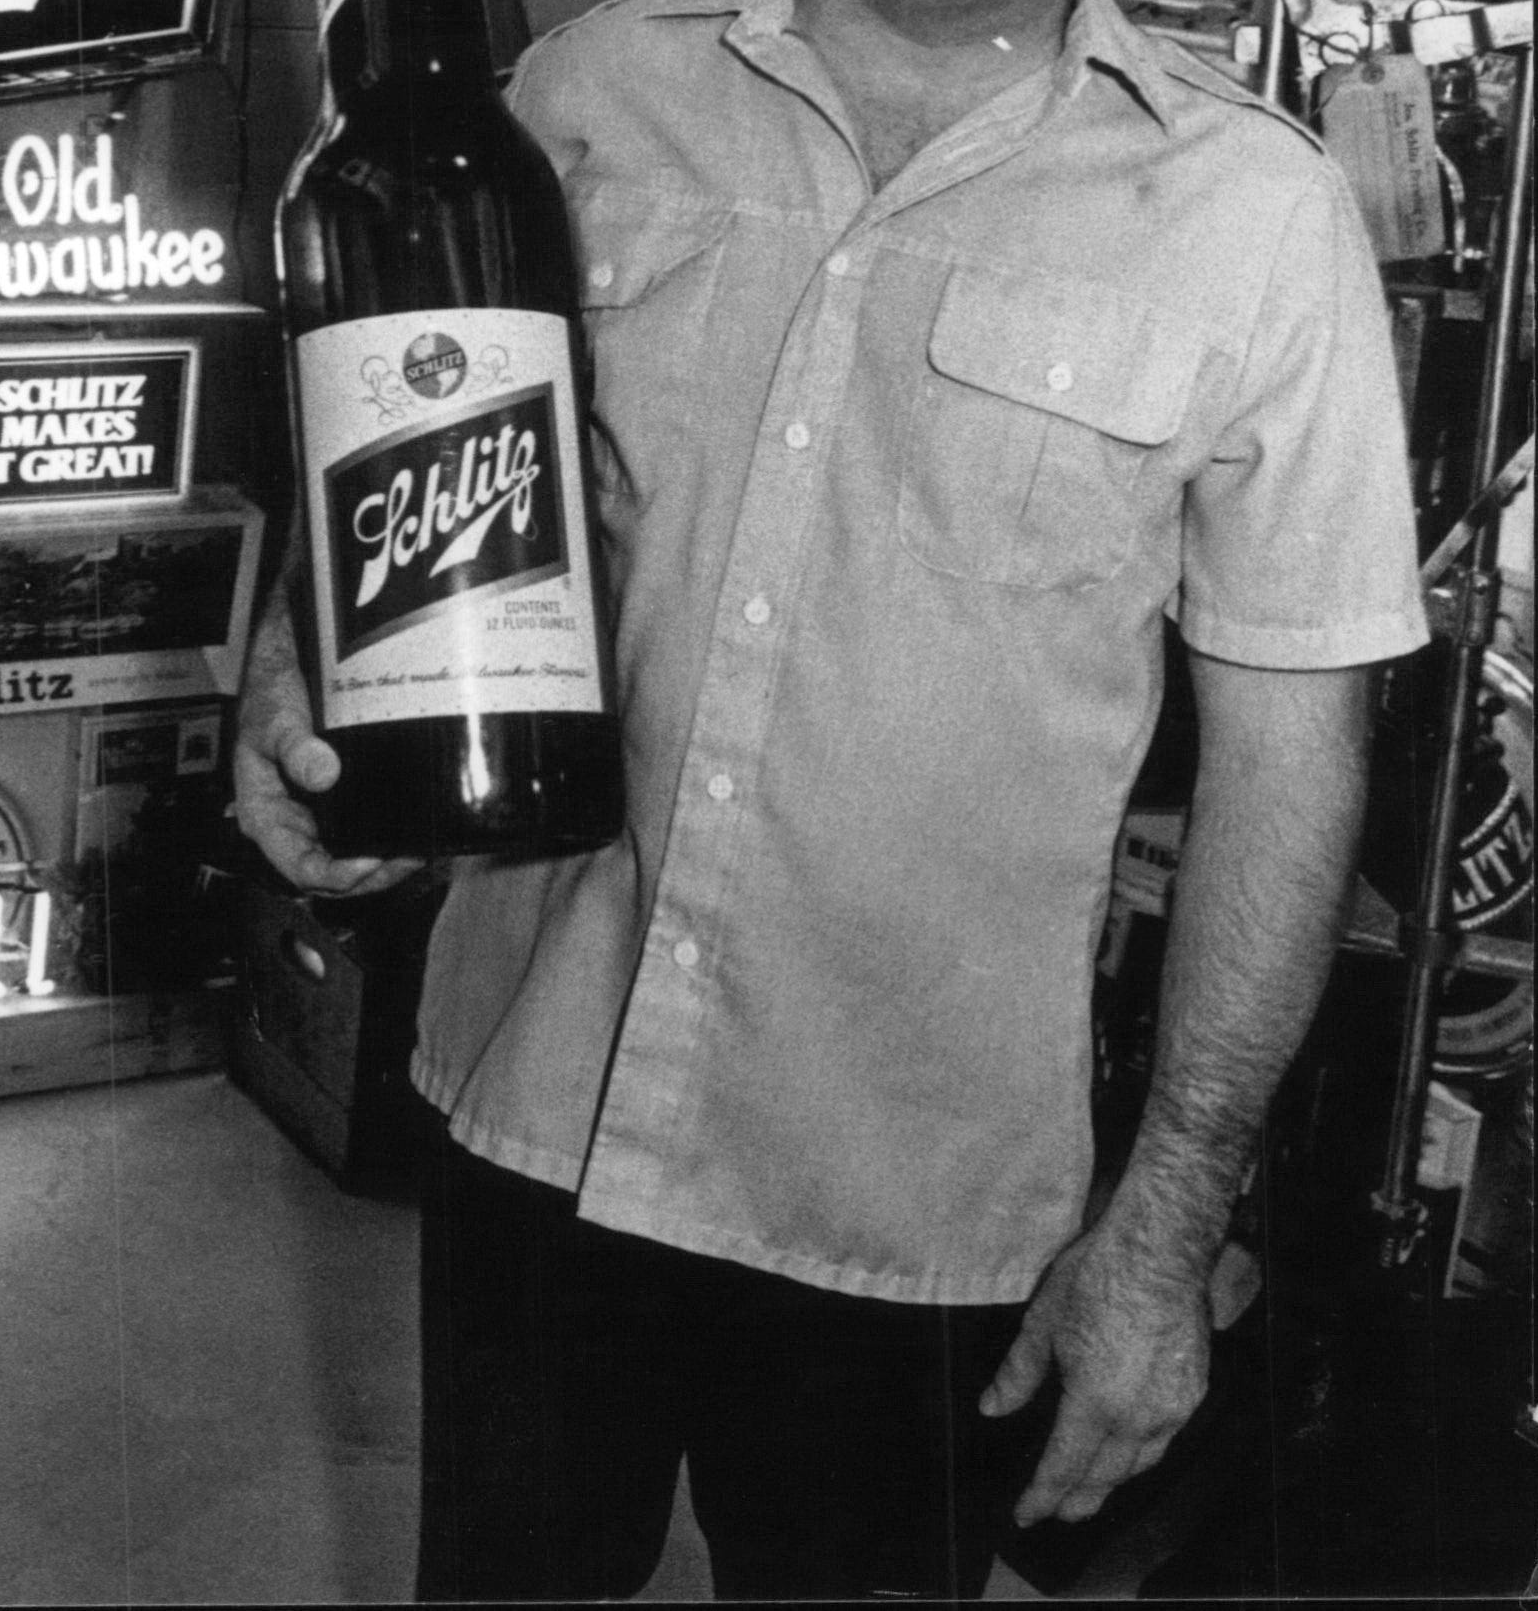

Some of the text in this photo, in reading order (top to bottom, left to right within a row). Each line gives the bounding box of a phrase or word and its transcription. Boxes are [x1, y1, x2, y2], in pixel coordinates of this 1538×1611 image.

[2, 133, 124, 227] Old
[405, 349, 465, 382] SCHLITZ
[18, 444, 155, 483] GREAT!
[352, 423, 541, 609] Schlitz
[503, 600, 562, 615] CONTENTS
